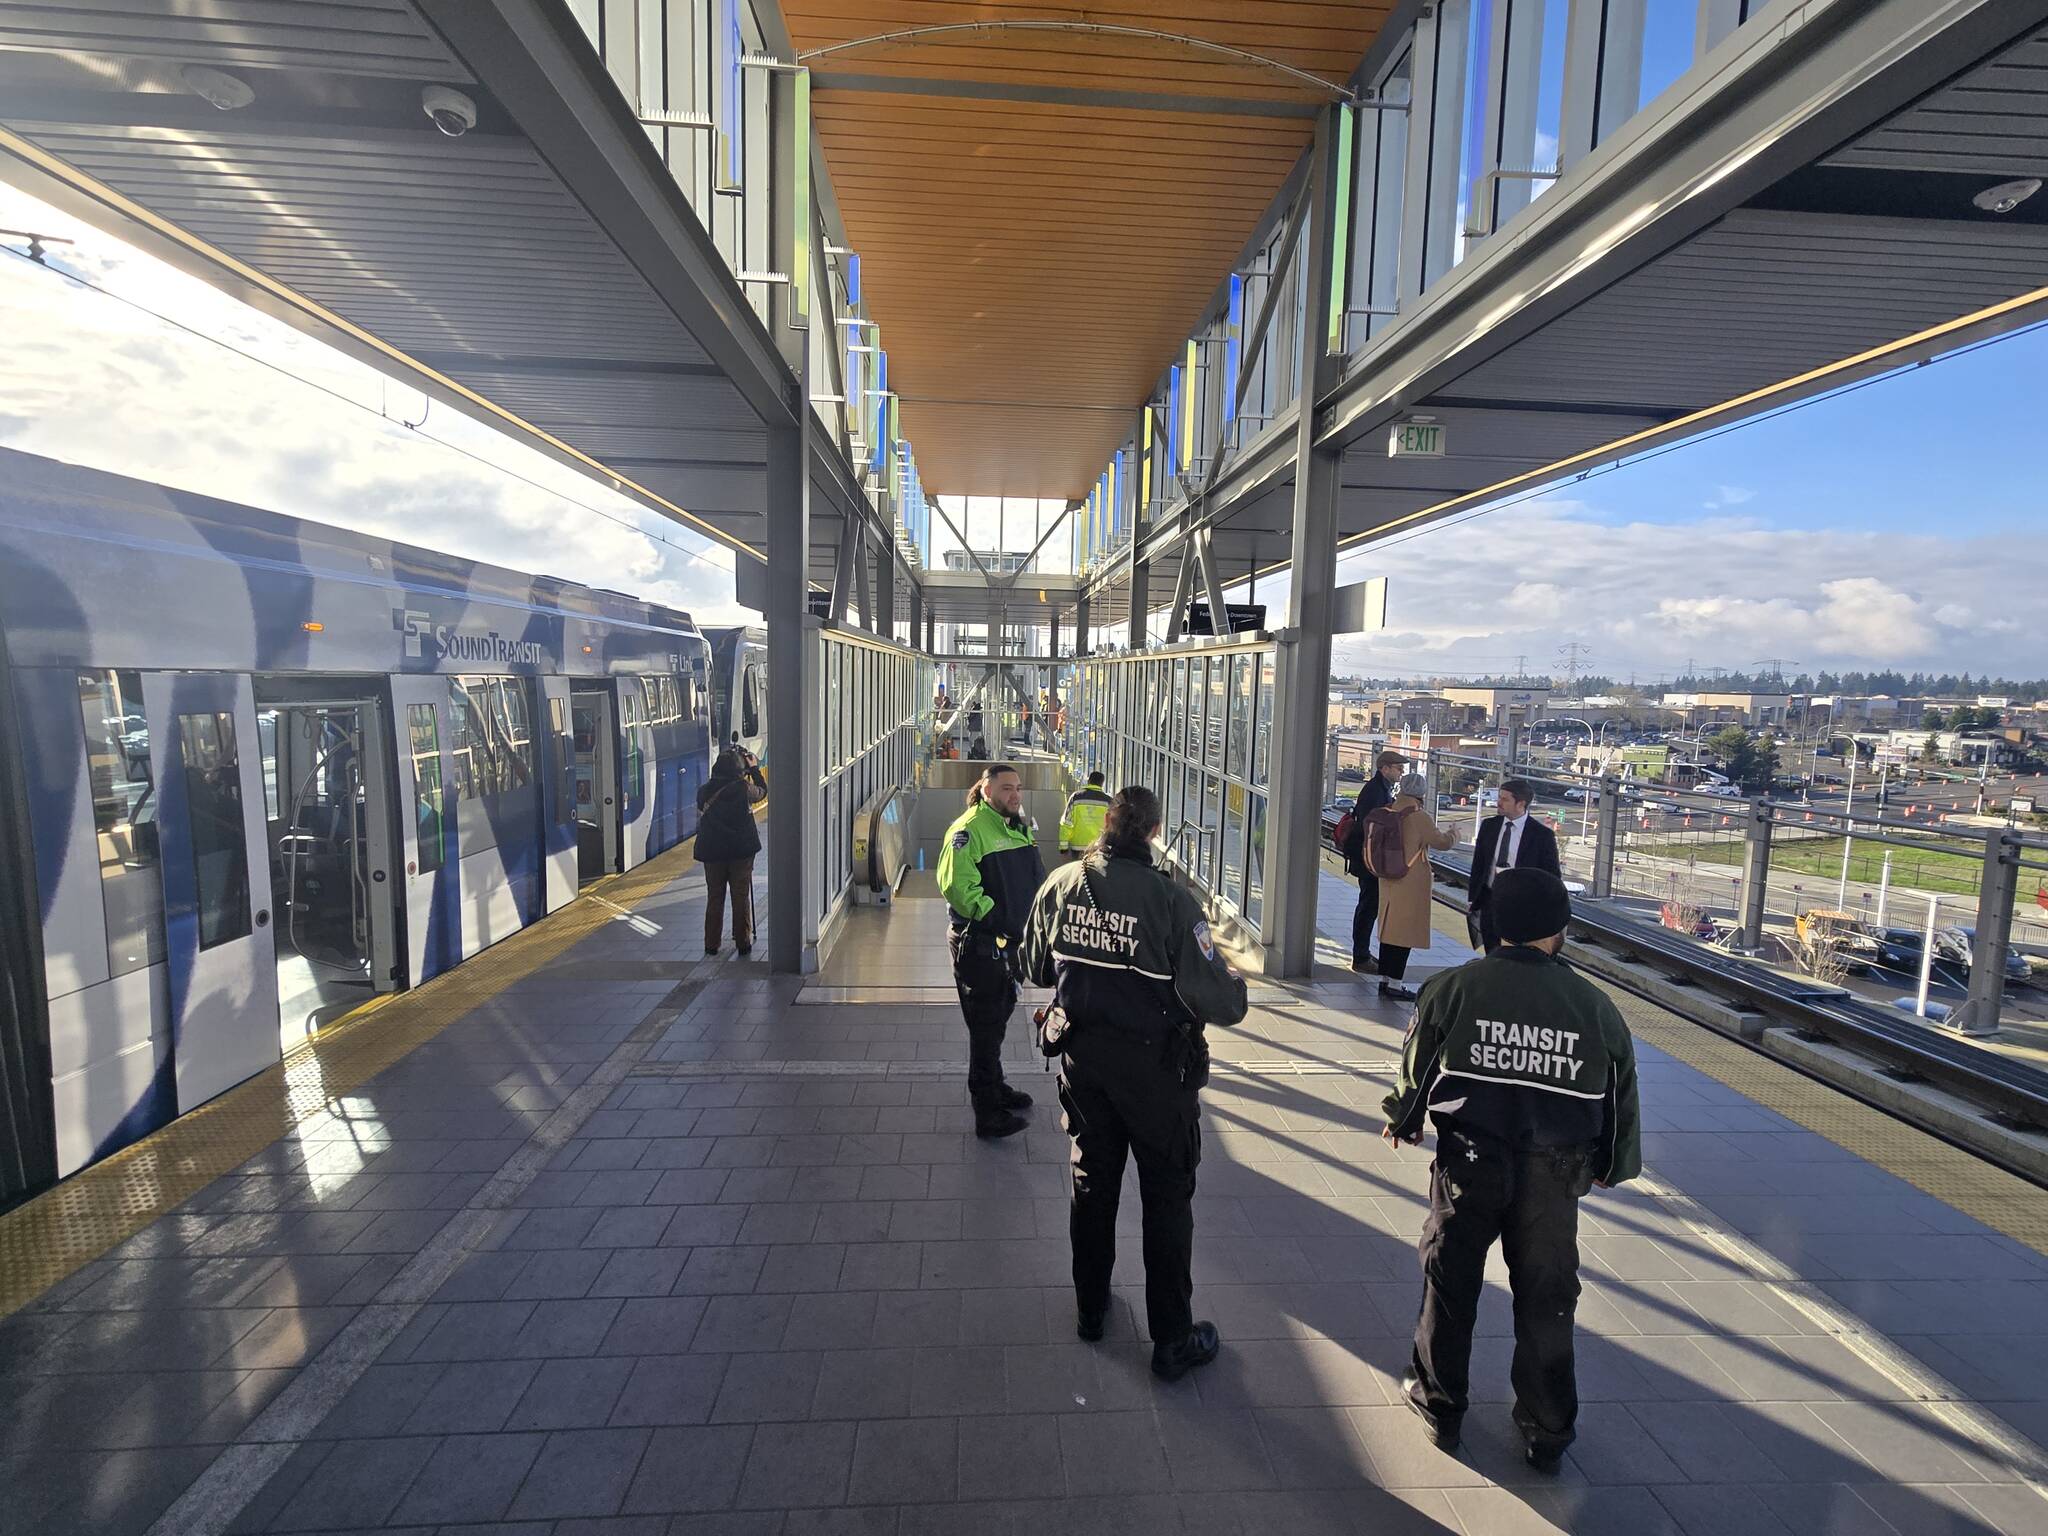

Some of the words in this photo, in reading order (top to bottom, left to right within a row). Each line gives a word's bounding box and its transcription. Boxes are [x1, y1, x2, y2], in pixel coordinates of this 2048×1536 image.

[1405, 426, 1440, 452] EXIT
[1476, 1019, 1580, 1055] TRANSIT
[1470, 1043, 1584, 1081] SECURITY
